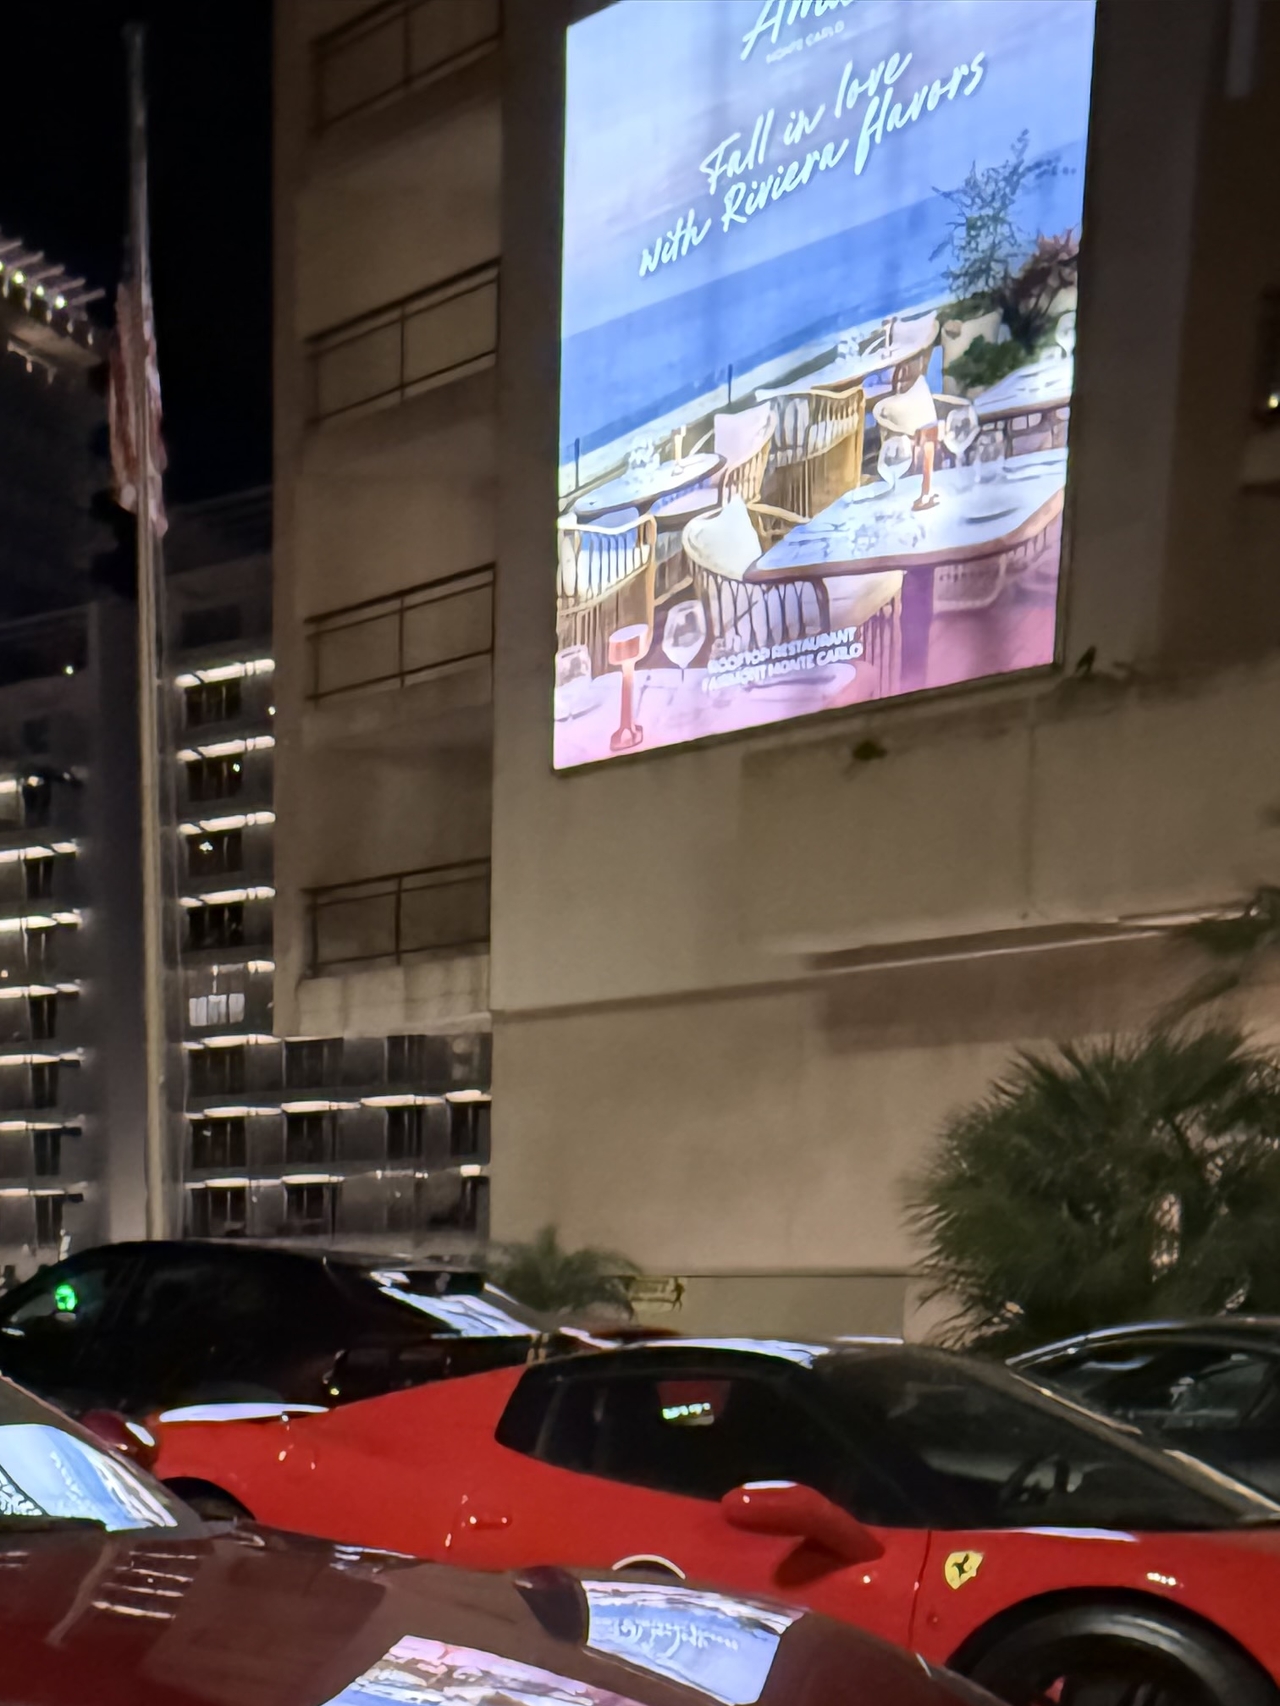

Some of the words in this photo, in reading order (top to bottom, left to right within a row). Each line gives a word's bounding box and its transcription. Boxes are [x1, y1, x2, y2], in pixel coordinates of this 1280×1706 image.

[639, 208, 712, 277] with
[721, 138, 850, 232] Riviera
[854, 51, 986, 175] flavors
[699, 108, 774, 195] Fall
[783, 103, 826, 145] in
[834, 52, 912, 119] love
[768, 653, 815, 677] MONTE
[816, 642, 863, 666] CARLO
[772, 626, 857, 659] RESTAURANT
